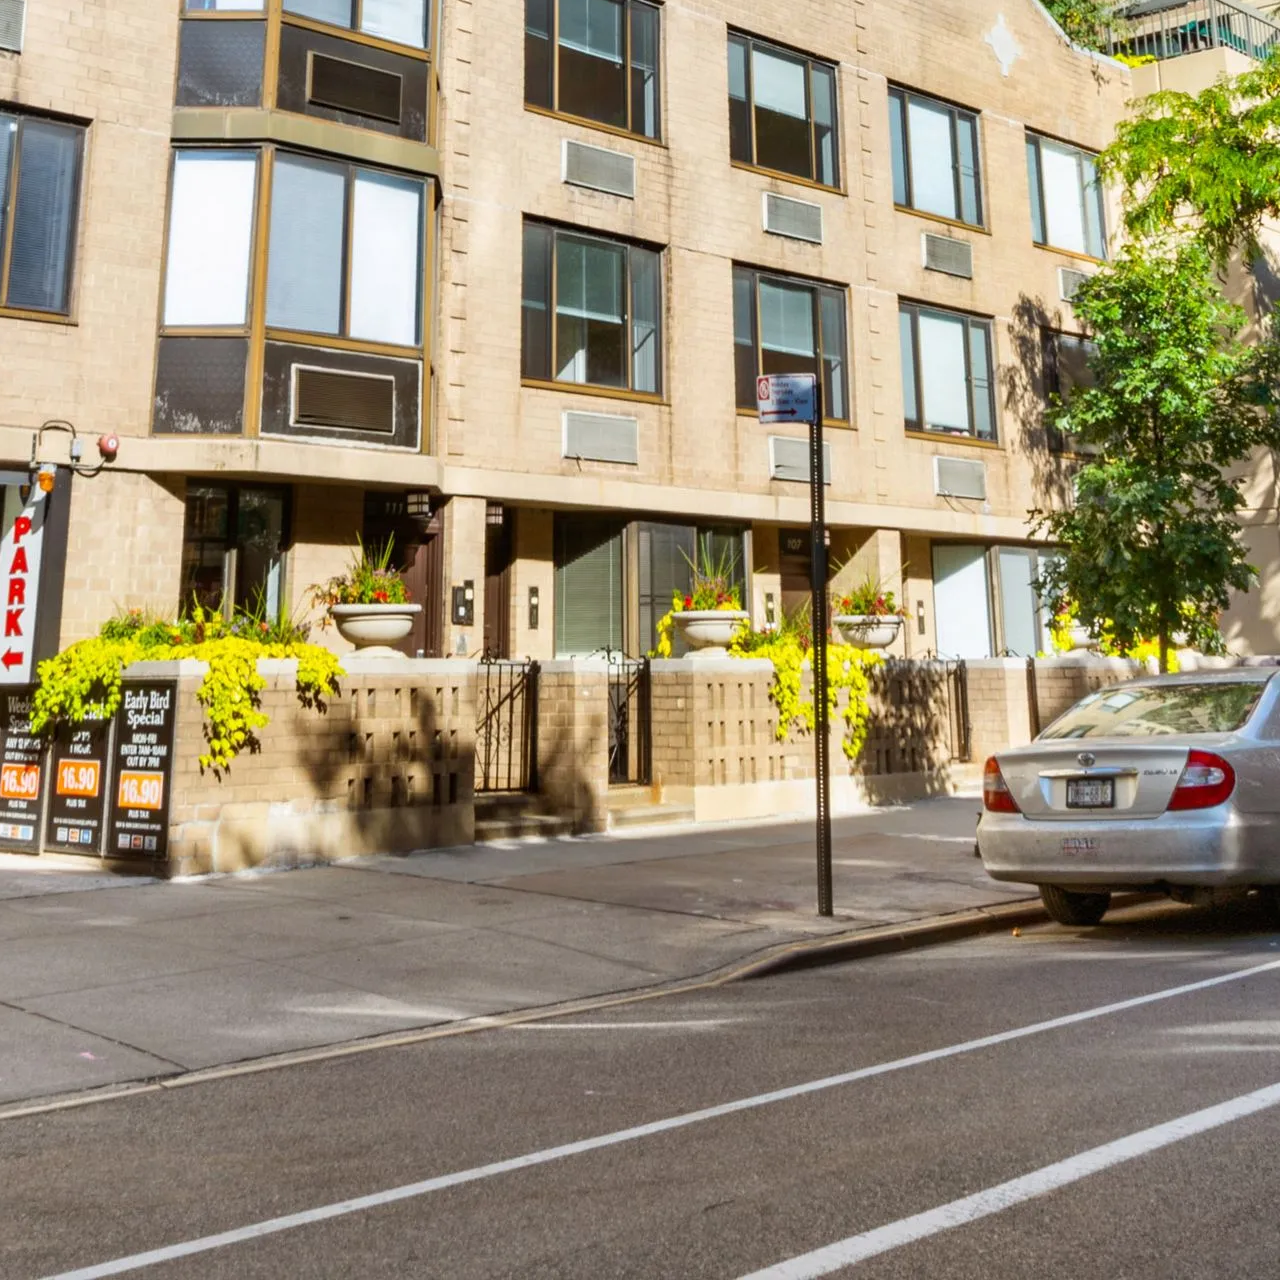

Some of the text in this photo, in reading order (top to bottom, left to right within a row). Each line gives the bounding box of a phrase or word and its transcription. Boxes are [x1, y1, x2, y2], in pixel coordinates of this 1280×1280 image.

[4, 516, 32, 637] PARK
[124, 689, 148, 715] Early
[149, 689, 170, 709] Bird
[127, 709, 164, 730] Special
[121, 745, 137, 755] ENTER
[127, 756, 138, 766] OUT
[139, 757, 147, 766] BY
[2, 770, 37, 793] 16.90
[62, 767, 95, 791] 16.90
[123, 779, 160, 804] 16.90
